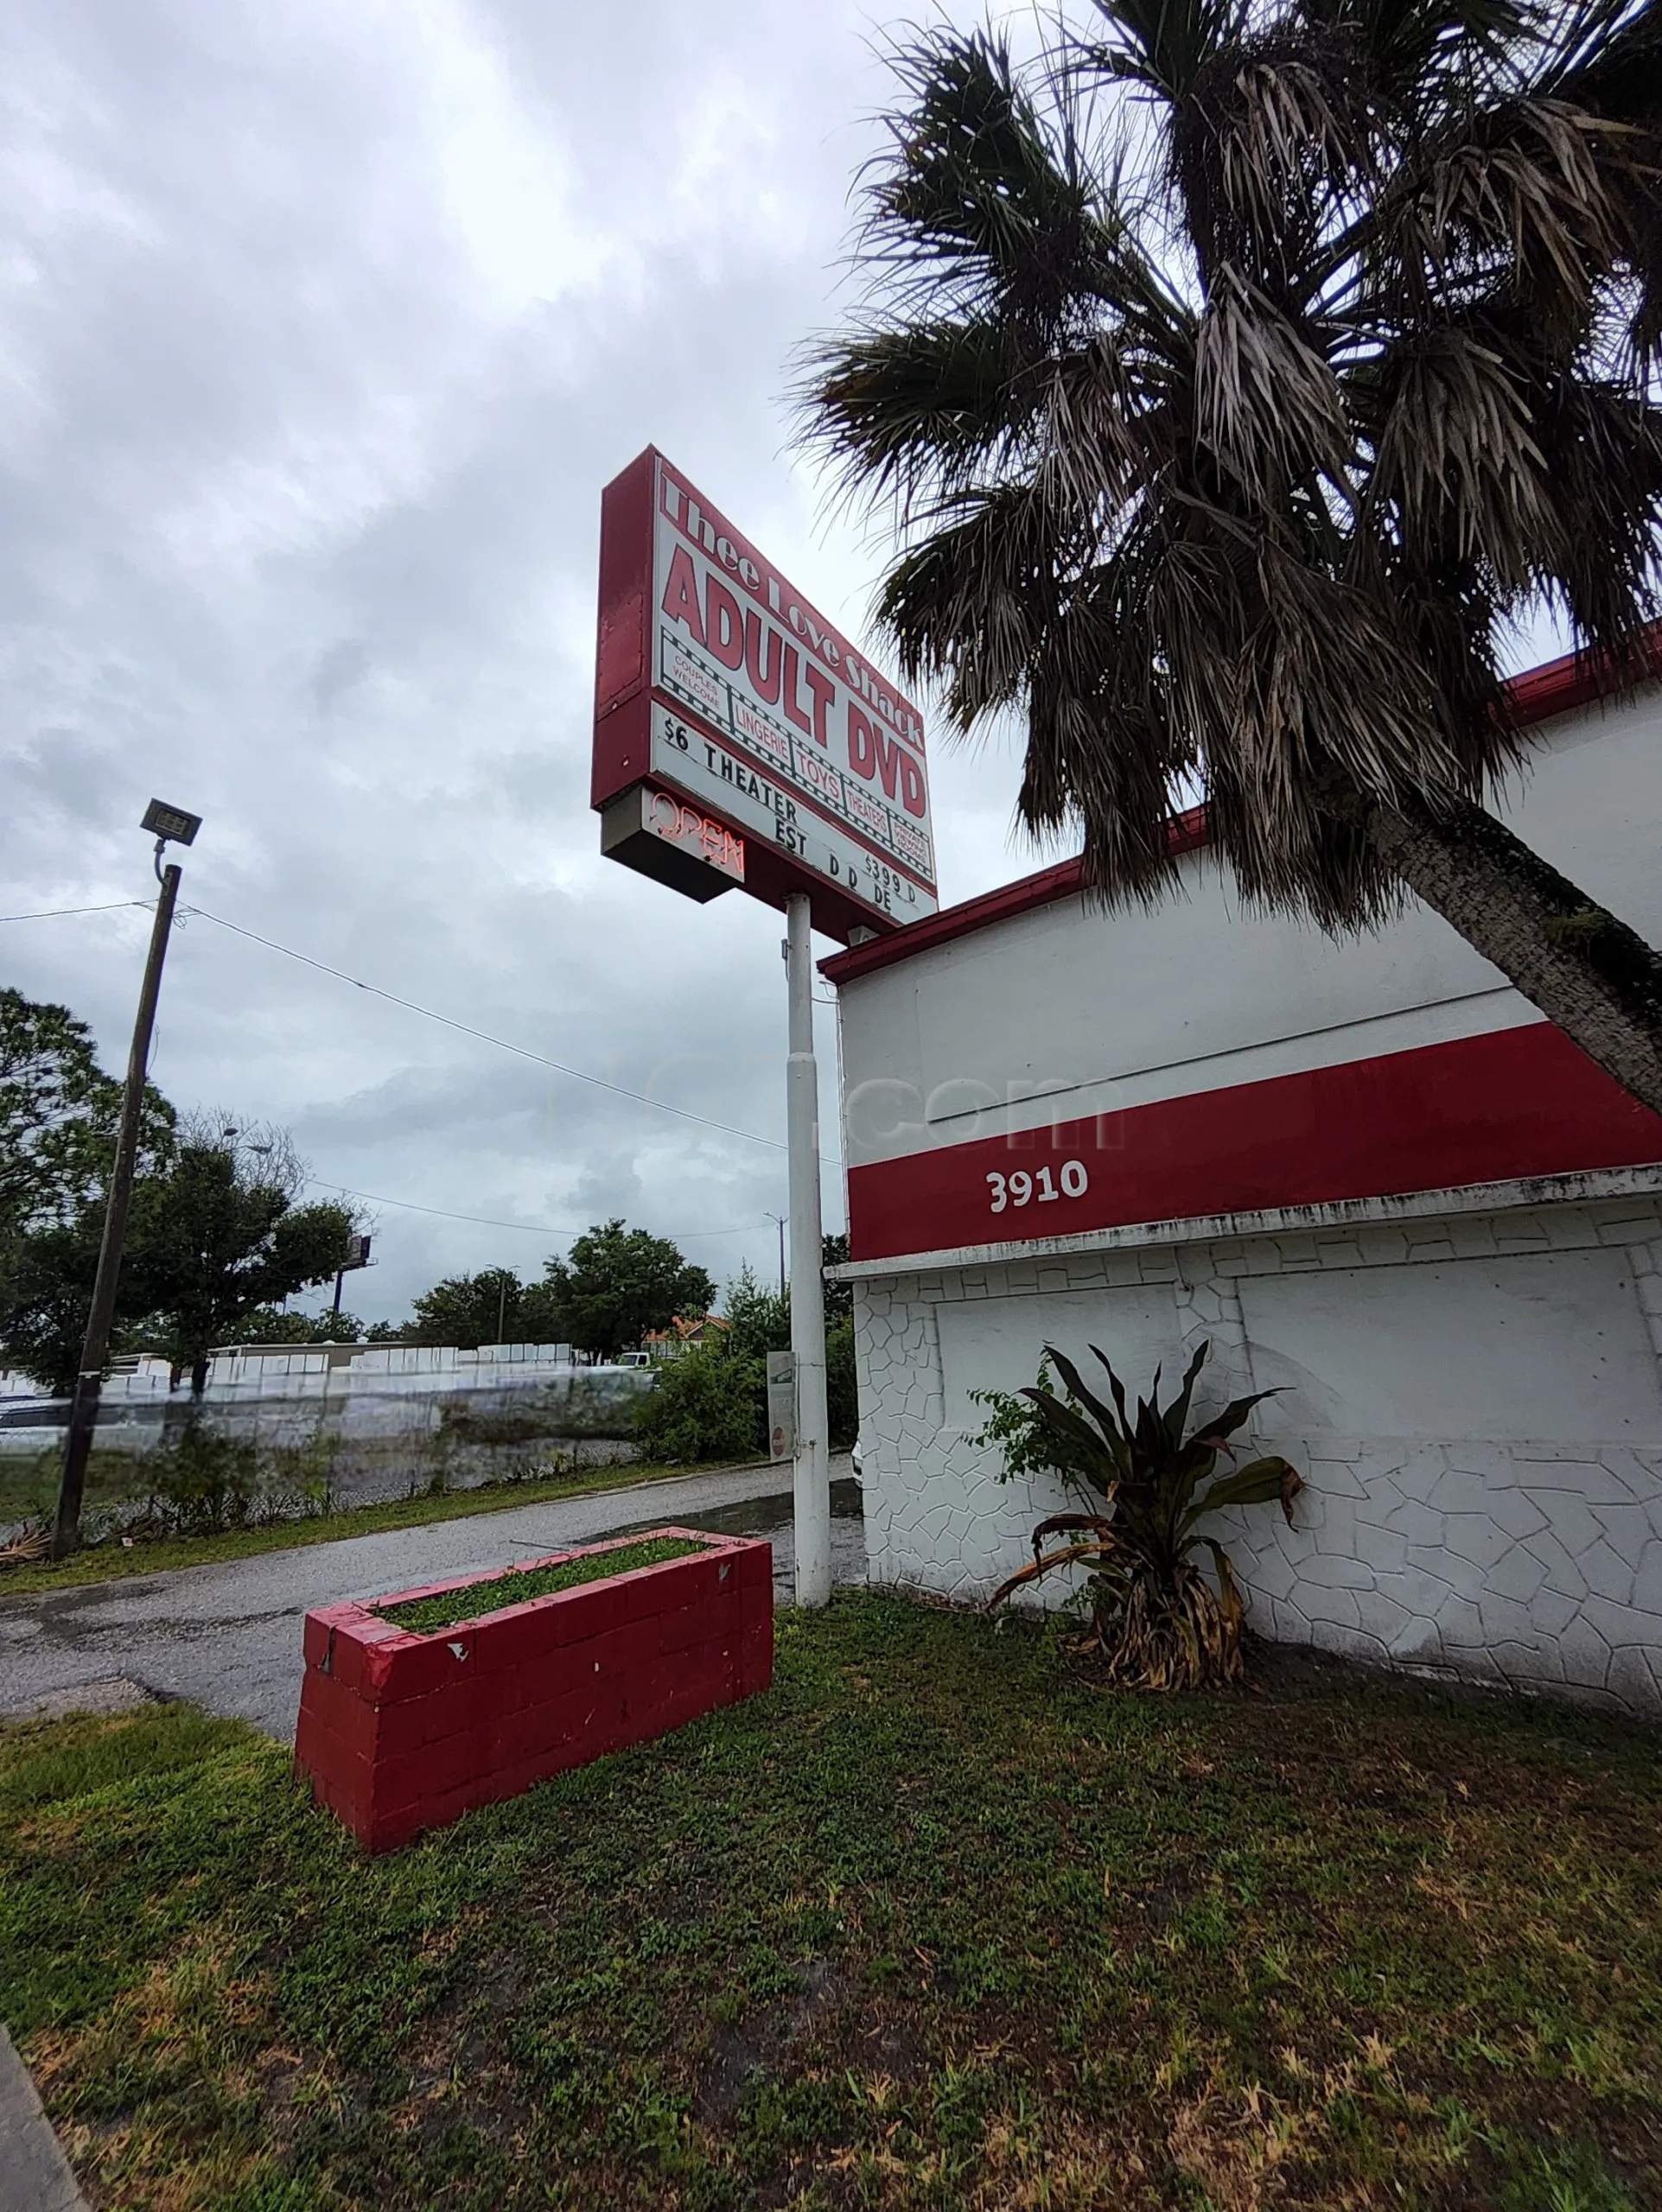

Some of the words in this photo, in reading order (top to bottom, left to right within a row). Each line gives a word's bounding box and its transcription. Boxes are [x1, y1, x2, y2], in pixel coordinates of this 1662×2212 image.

[661, 473, 761, 591] Thee
[768, 576, 841, 667] Love
[845, 654, 925, 752] Shack
[661, 543, 836, 750] ADULT
[848, 698, 927, 819] DVD
[672, 665, 722, 709] WELCOME
[674, 655, 718, 696] COUPLES
[735, 704, 789, 760] LINGERIE
[796, 750, 840, 799] TOYS
[665, 717, 689, 751] $6
[704, 741, 797, 824] THEATER
[865, 855, 901, 893] $399
[847, 790, 887, 833] THEATERS
[652, 792, 744, 872] OPEN
[775, 817, 807, 855] EST
[986, 1160, 1088, 1213] 3910
